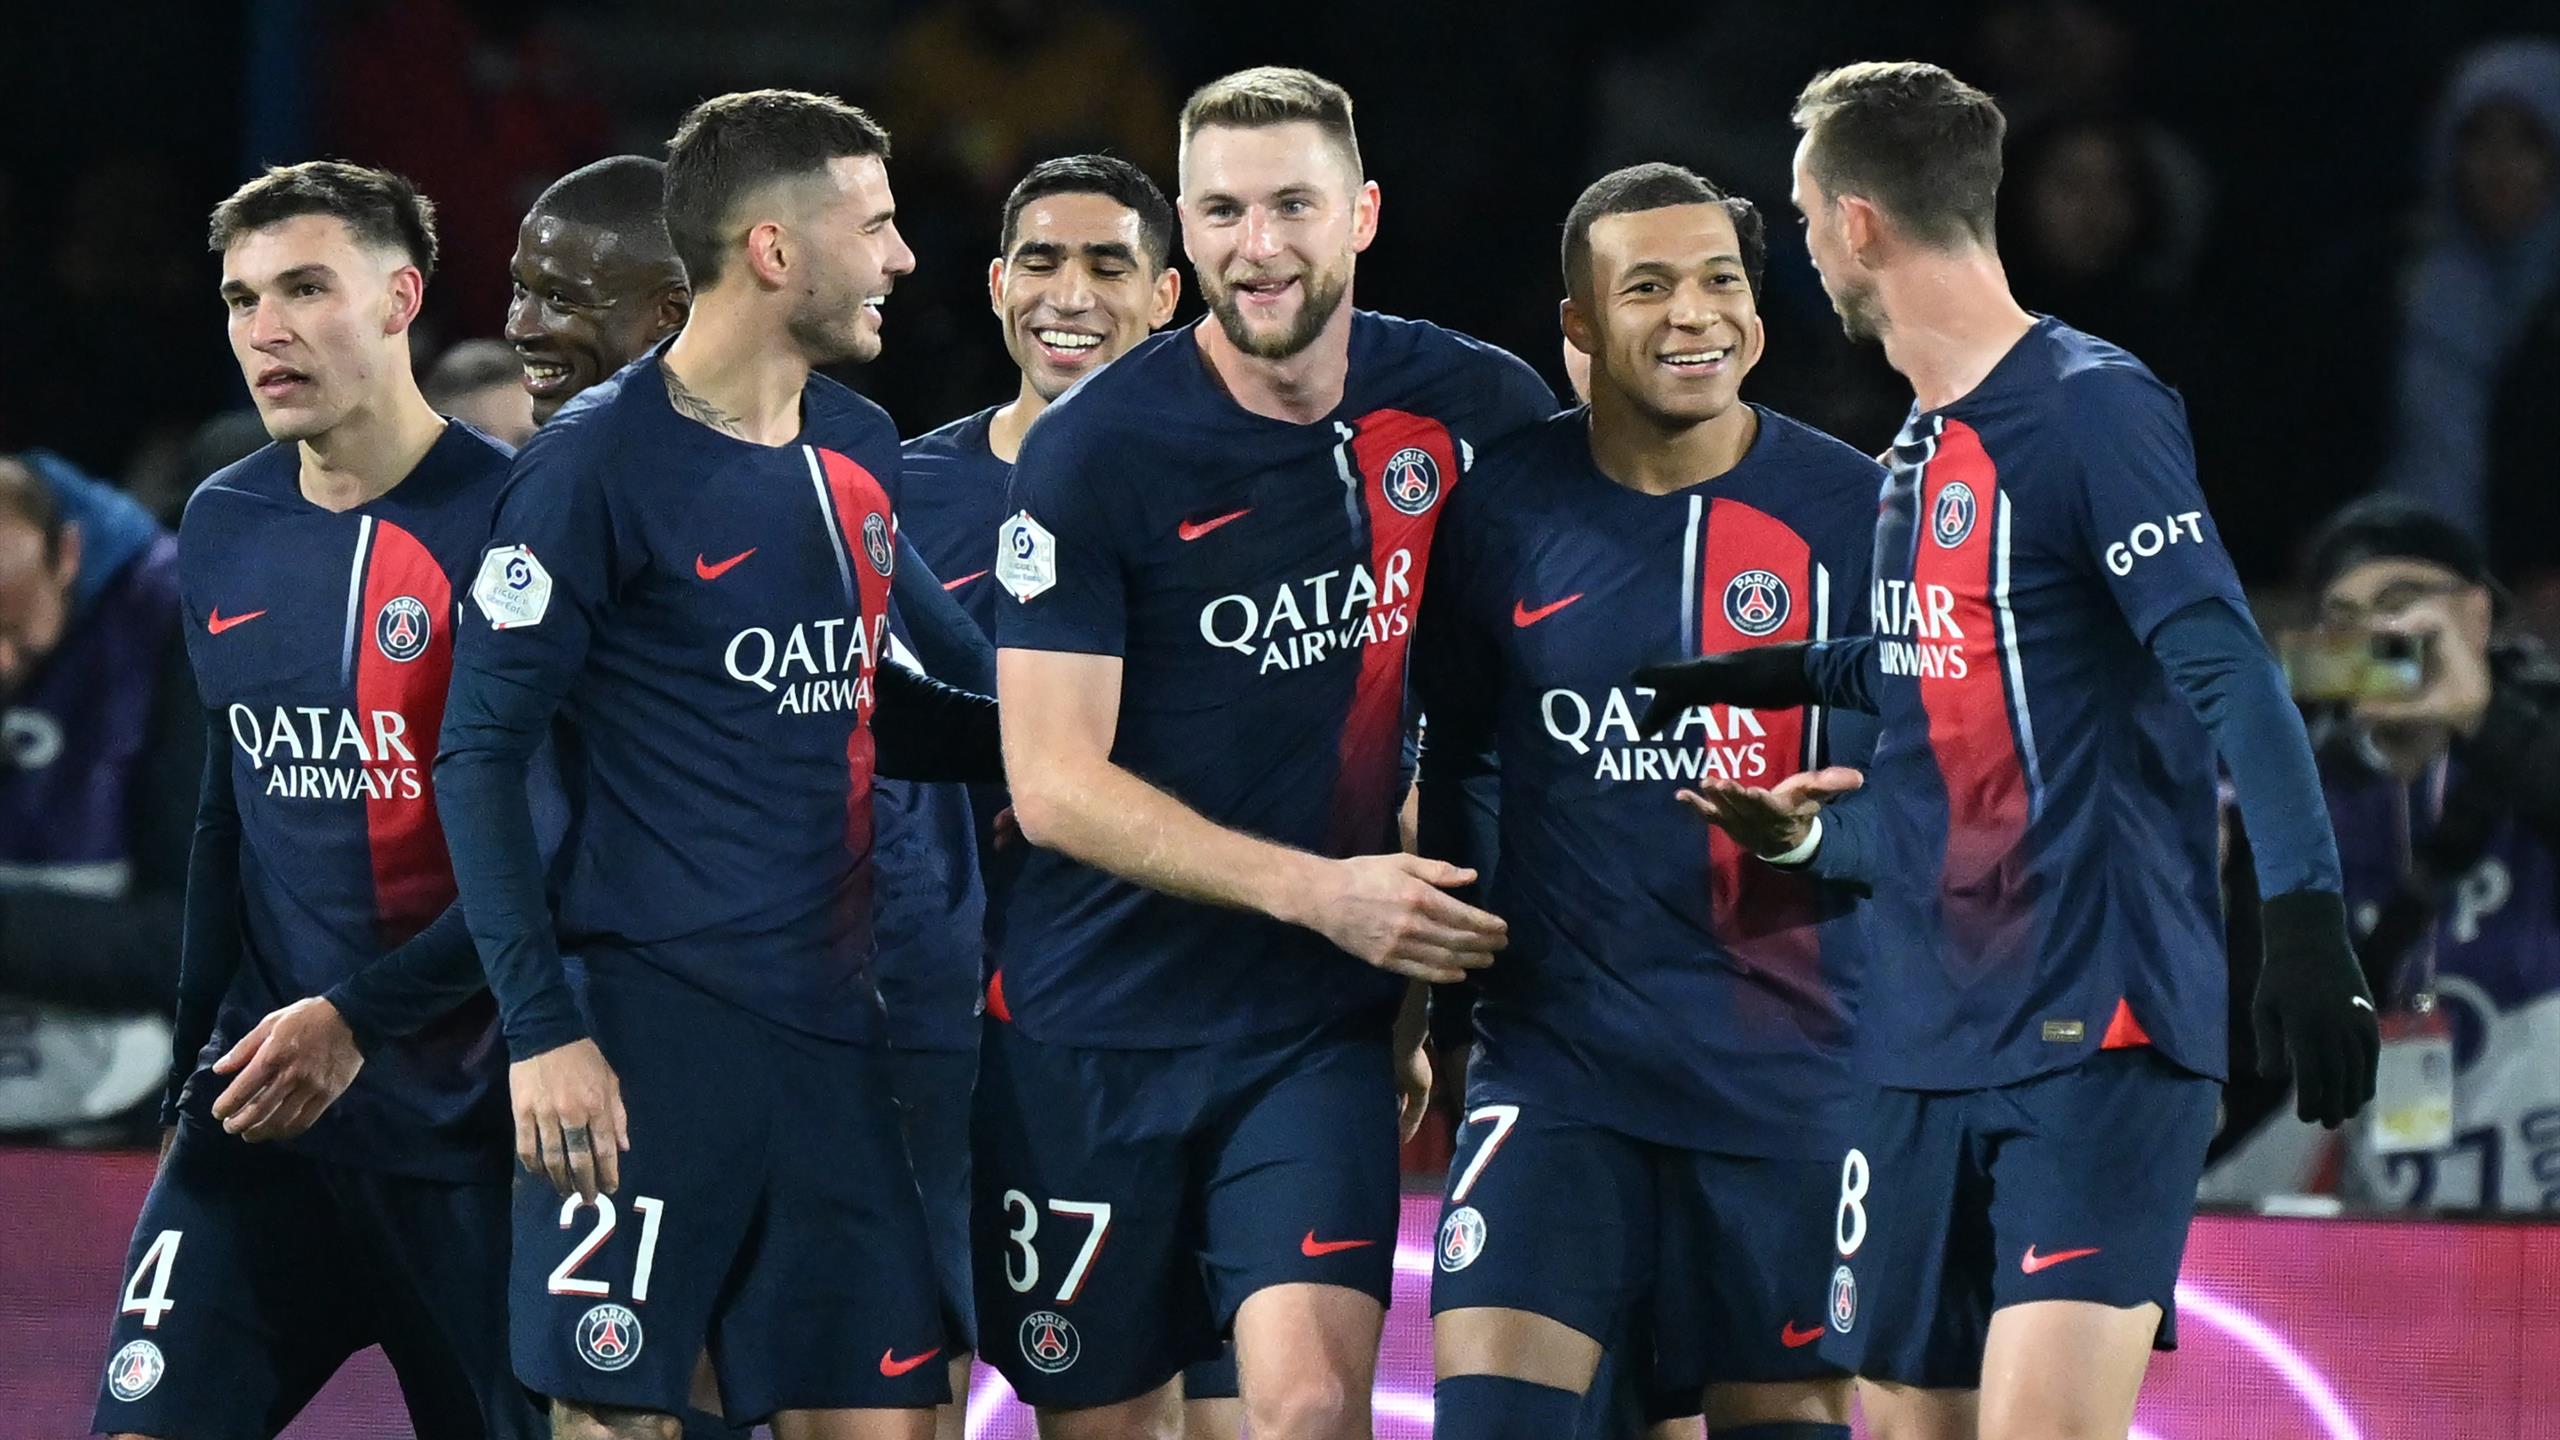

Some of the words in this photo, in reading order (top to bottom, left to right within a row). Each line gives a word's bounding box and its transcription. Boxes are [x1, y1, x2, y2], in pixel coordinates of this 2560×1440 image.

[1389, 451, 1426, 472] PARIS
[2106, 511, 2204, 576] GOAT
[386, 599, 422, 616] PARIS
[1200, 548, 1412, 656] QATAR
[1734, 573, 1779, 590] PARIS
[1259, 603, 1409, 675] AIRWAYS
[228, 703, 417, 770] QATAR
[1593, 742, 1767, 781] AIRWAYS
[265, 764, 422, 799] AIRWAYS
[1451, 1105, 1520, 1204] 7
[1836, 1148, 1870, 1259] 8
[121, 1229, 184, 1329] 4
[547, 1190, 664, 1303] 21
[1003, 1189, 1113, 1304] 37
[588, 1307, 632, 1328] PARIS
[1029, 1313, 1069, 1331] PARIS
